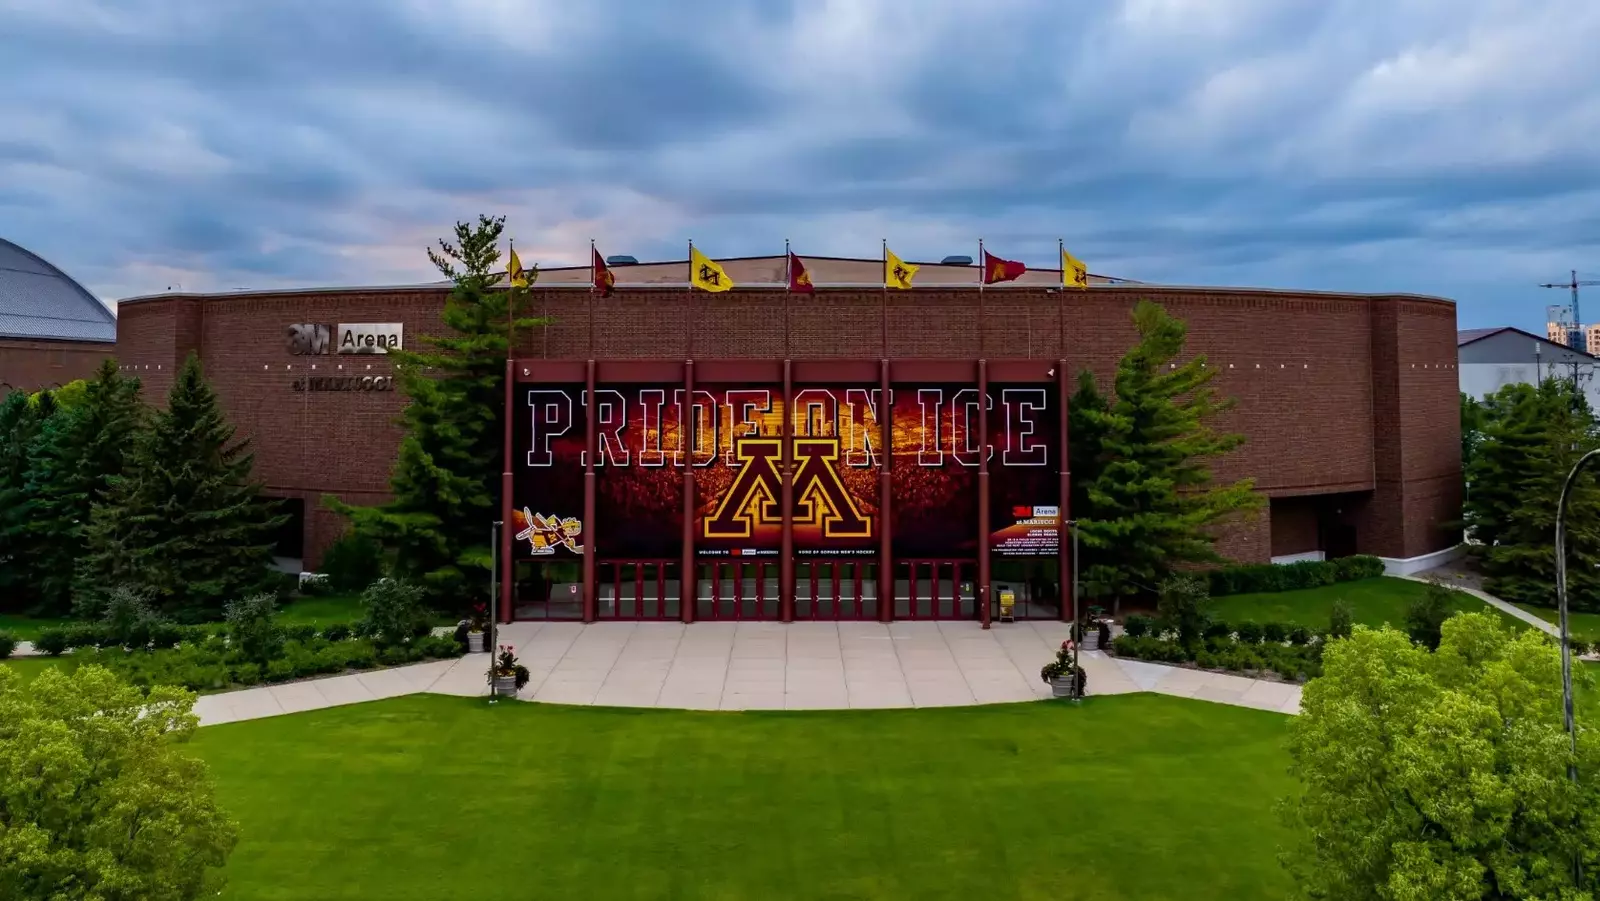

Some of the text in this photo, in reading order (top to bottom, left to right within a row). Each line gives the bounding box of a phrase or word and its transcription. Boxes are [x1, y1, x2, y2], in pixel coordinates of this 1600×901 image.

[288, 323, 398, 355] 3M Arena
[527, 388, 1047, 467] PRIDE ON ICE
